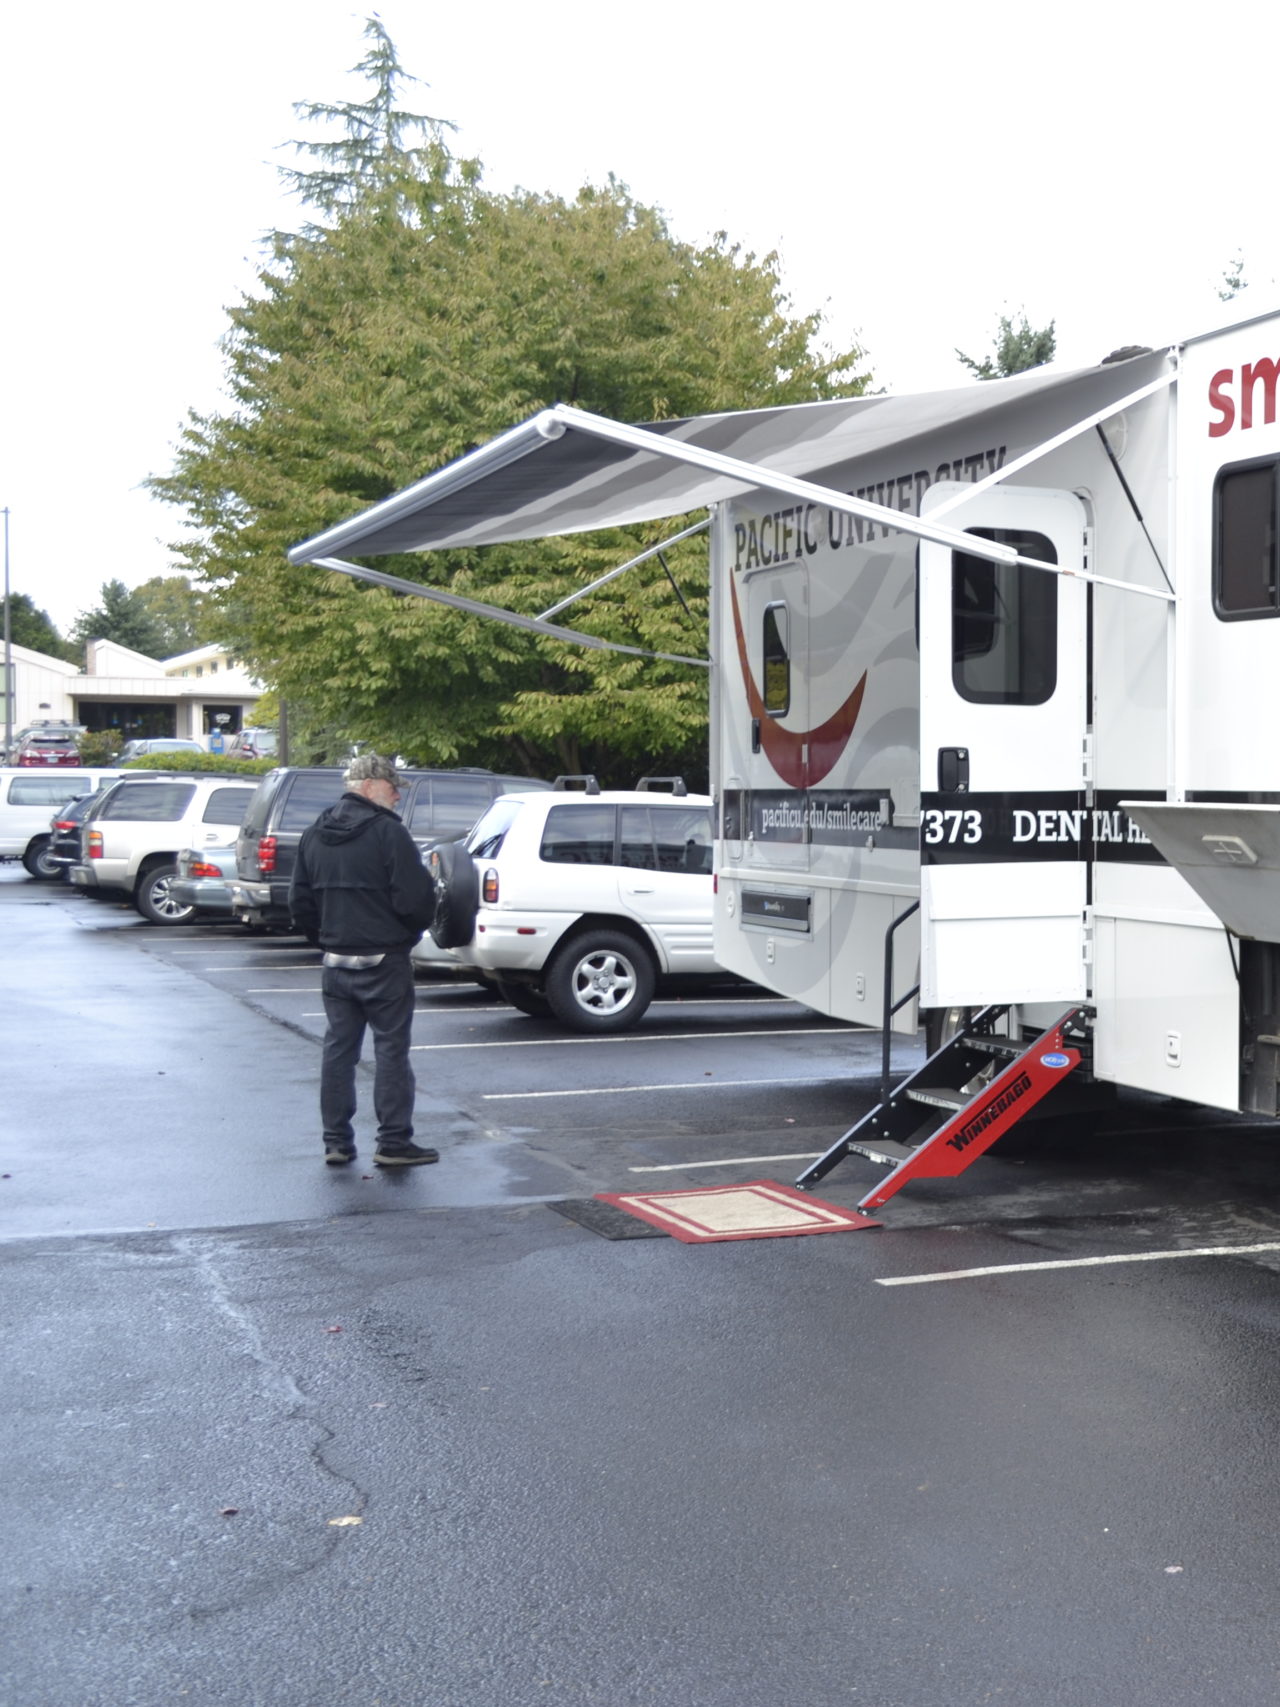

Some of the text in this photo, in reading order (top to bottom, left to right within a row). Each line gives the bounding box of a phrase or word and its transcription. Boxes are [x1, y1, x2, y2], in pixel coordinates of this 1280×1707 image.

[734, 503, 818, 572] PACIFIC
[920, 809, 982, 844] 373
[1012, 810, 1123, 843] DENTAL
[946, 1071, 1033, 1152] WINNEBAGO
